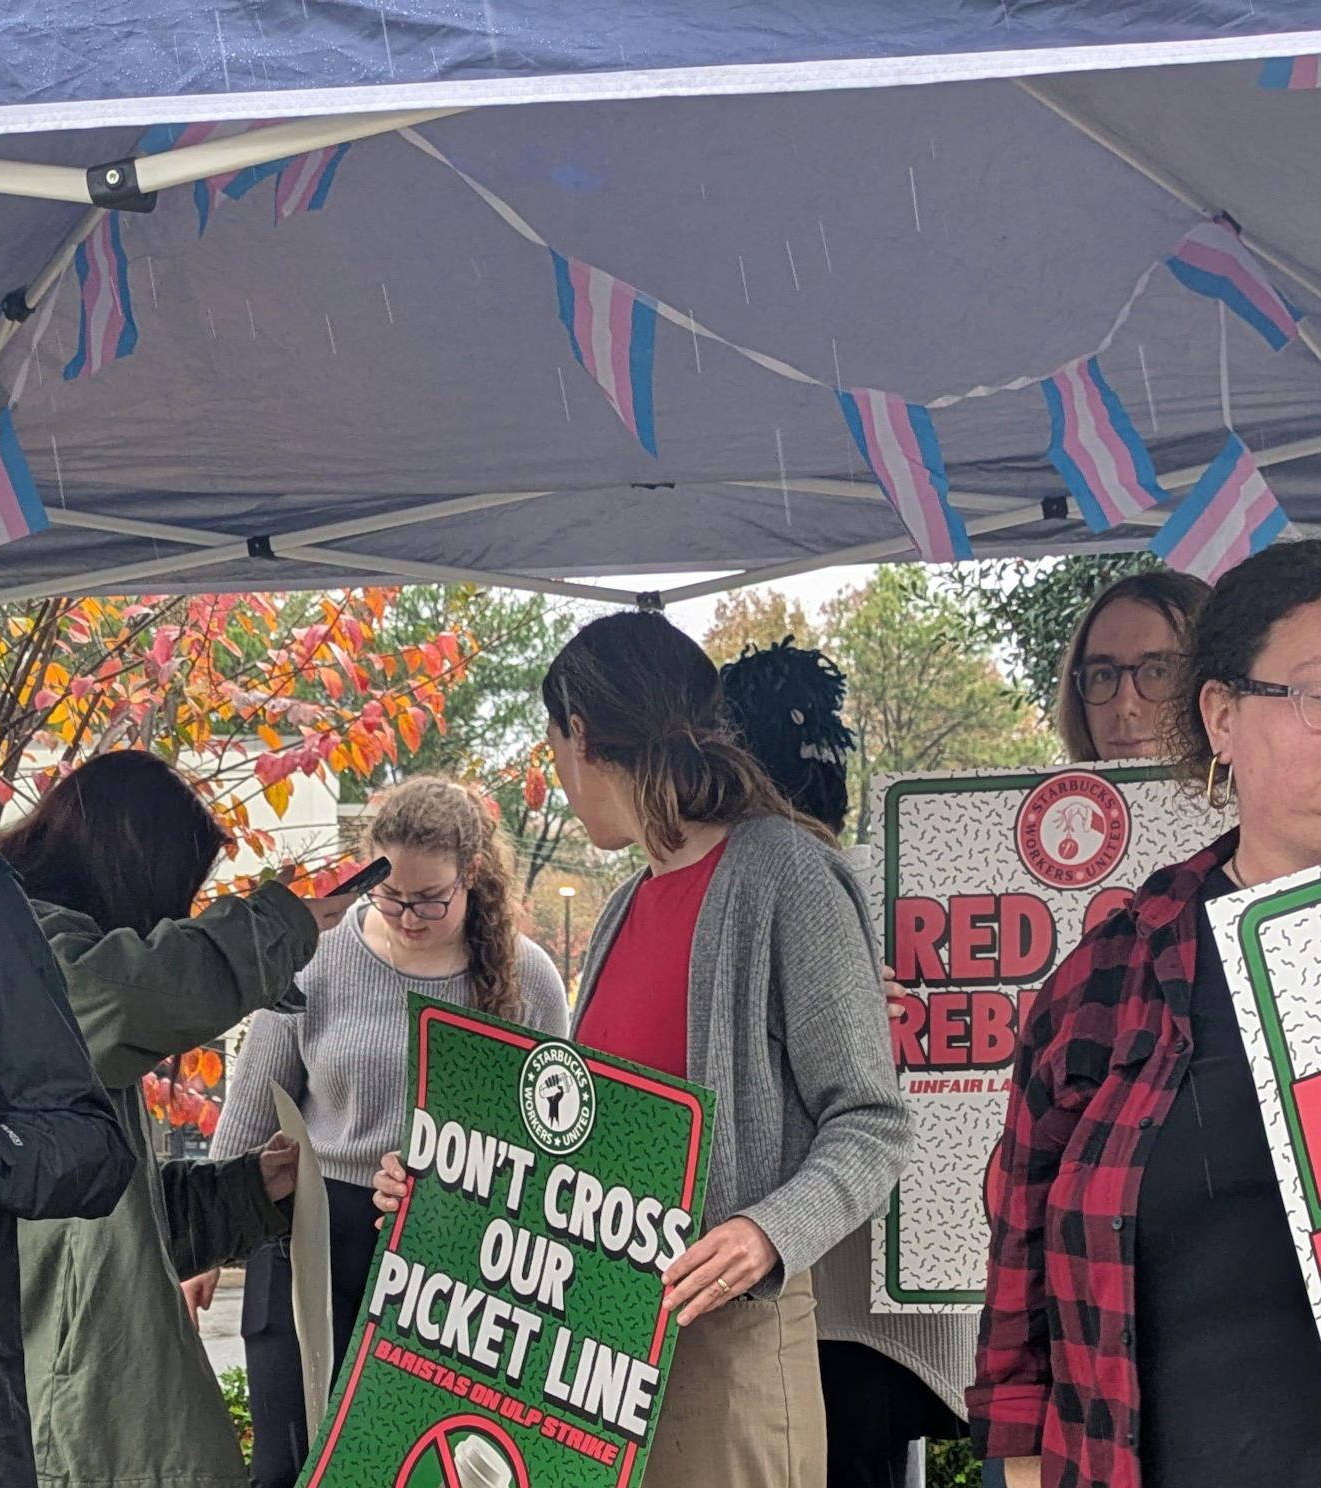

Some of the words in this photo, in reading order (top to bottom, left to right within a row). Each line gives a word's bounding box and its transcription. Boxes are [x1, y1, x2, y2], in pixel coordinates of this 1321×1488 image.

[1032, 781, 1115, 814] STARBUCKS
[1025, 823, 1074, 881] WORKERS
[1086, 820, 1120, 877] UNITED
[895, 892, 1057, 987] RED
[532, 1049, 587, 1088] STARBUCKS
[909, 1079, 983, 1094] UNFAIR
[524, 1087, 553, 1145] WORKERS
[562, 1106, 590, 1146] UNITED
[406, 1107, 535, 1217] DON'T
[544, 1162, 692, 1274] CROSS
[479, 1218, 574, 1313] OUR
[368, 1250, 542, 1381] PICKET
[544, 1327, 660, 1438] LINE
[374, 1340, 472, 1397] BARISTAS
[468, 1383, 502, 1411] ON
[499, 1397, 544, 1428] ULP
[540, 1415, 620, 1466] STRIKE
